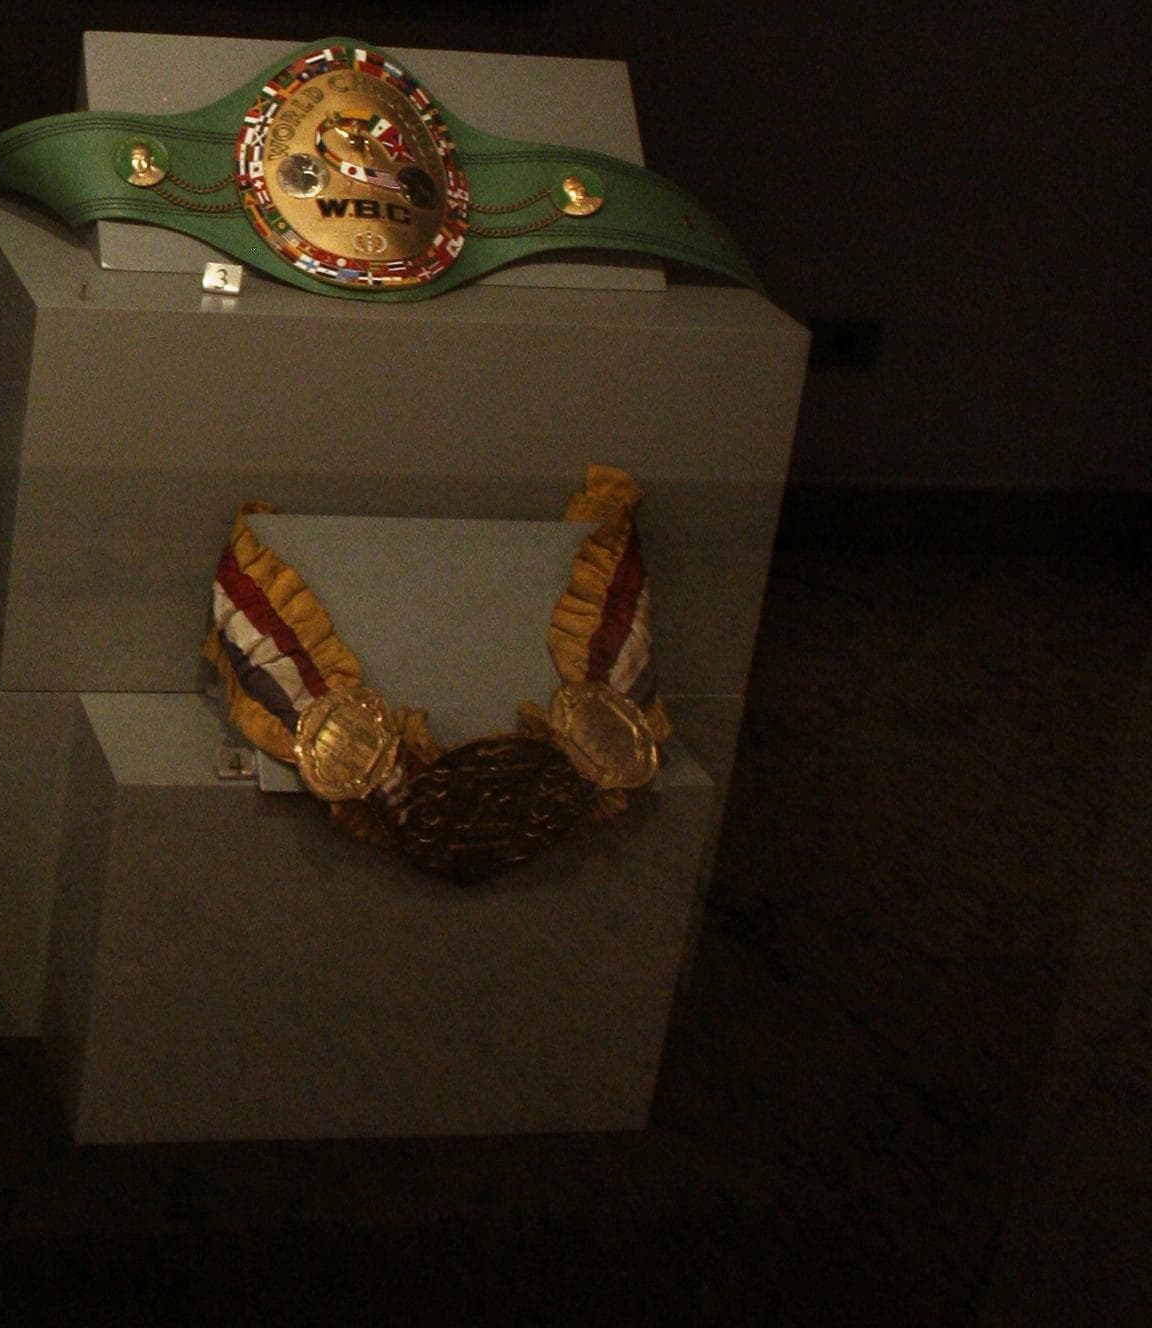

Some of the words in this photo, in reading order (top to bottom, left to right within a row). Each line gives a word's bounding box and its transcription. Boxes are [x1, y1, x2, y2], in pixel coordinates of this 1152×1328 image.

[268, 86, 326, 162] WORLD
[214, 268, 228, 290] 3
[229, 752, 245, 776] 4
